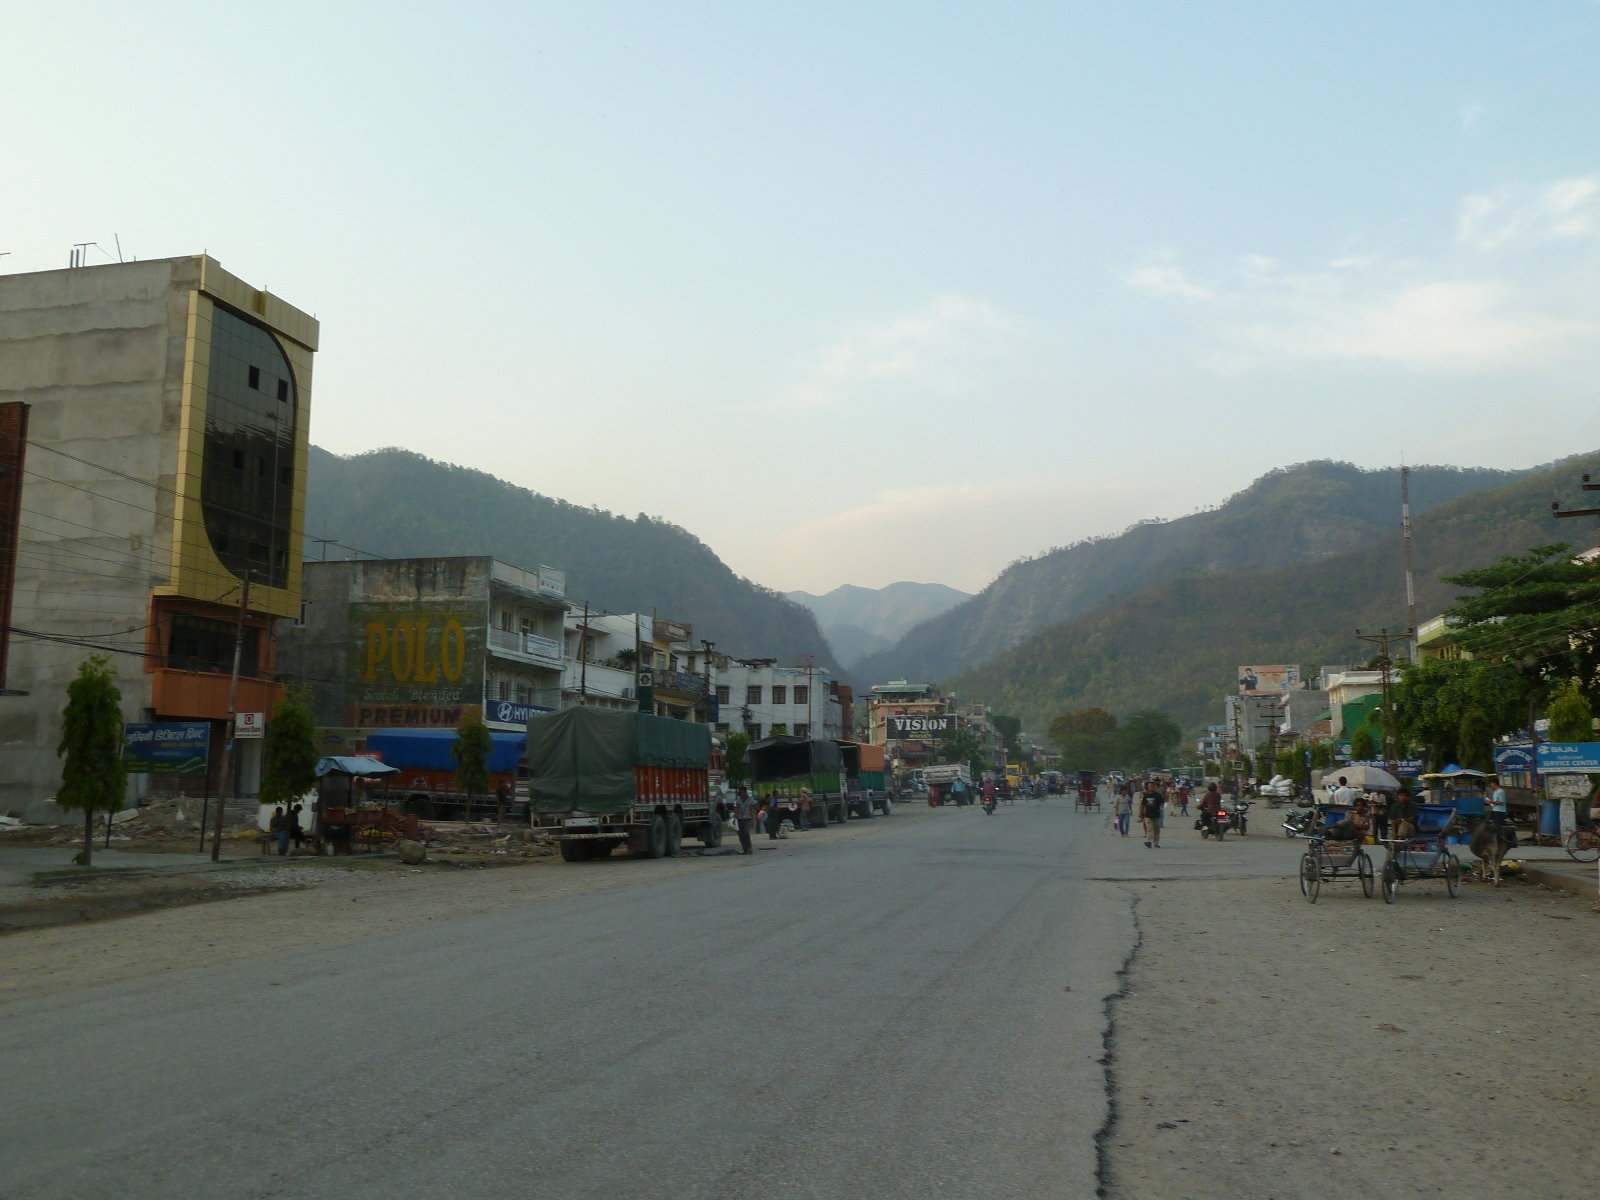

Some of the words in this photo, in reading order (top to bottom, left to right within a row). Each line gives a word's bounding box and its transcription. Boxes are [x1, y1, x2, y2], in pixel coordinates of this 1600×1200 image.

[363, 618, 466, 684] POLO
[364, 687, 400, 701] Scotch
[410, 688, 462, 703] Blended
[360, 707, 462, 724] PREMIUM
[895, 719, 948, 731] VISION
